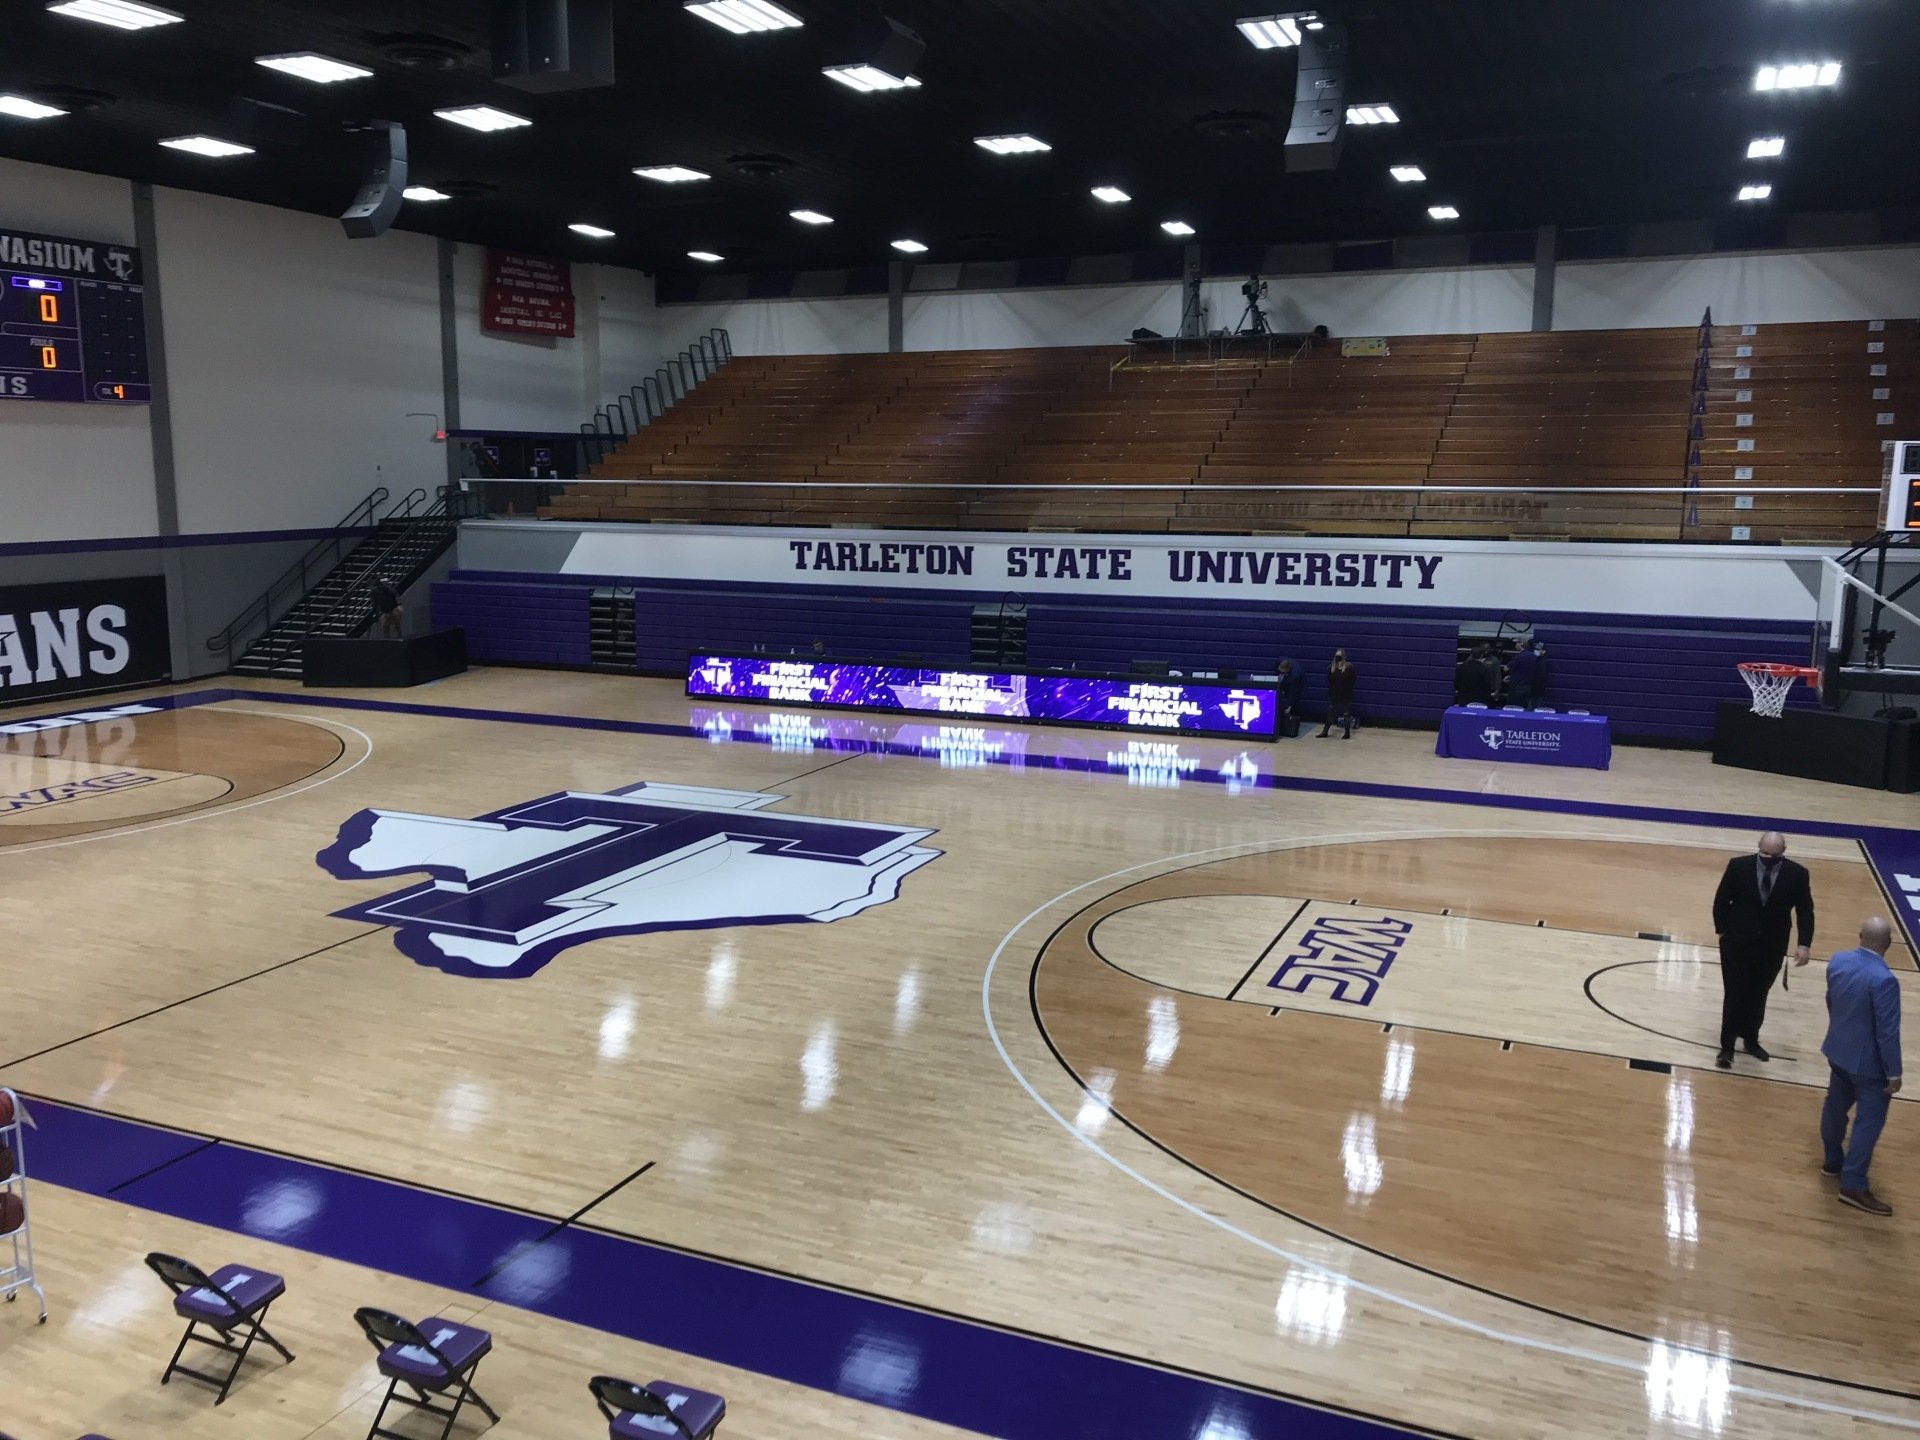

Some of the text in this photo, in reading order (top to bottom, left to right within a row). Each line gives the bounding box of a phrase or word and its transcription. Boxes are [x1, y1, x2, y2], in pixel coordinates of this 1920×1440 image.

[40, 294, 58, 322] 0
[42, 346, 57, 369] 0
[113, 384, 125, 399] 4
[790, 541, 1443, 589] TARLETON STATE UNIVERSITY
[0, 604, 130, 687] ANS
[770, 662, 814, 675] FIRST
[752, 673, 829, 690] FINANCIAL
[940, 673, 988, 688] FIRST
[769, 687, 811, 700] BANK
[921, 684, 1006, 702] FINANCIAL
[1129, 684, 1183, 699] FIRST
[939, 698, 986, 713] BANK
[1108, 696, 1202, 715] FINANCIAL
[1128, 711, 1180, 727] BANK
[1505, 730, 1561, 741] TARLETON
[1267, 917, 1413, 1006] WAC
